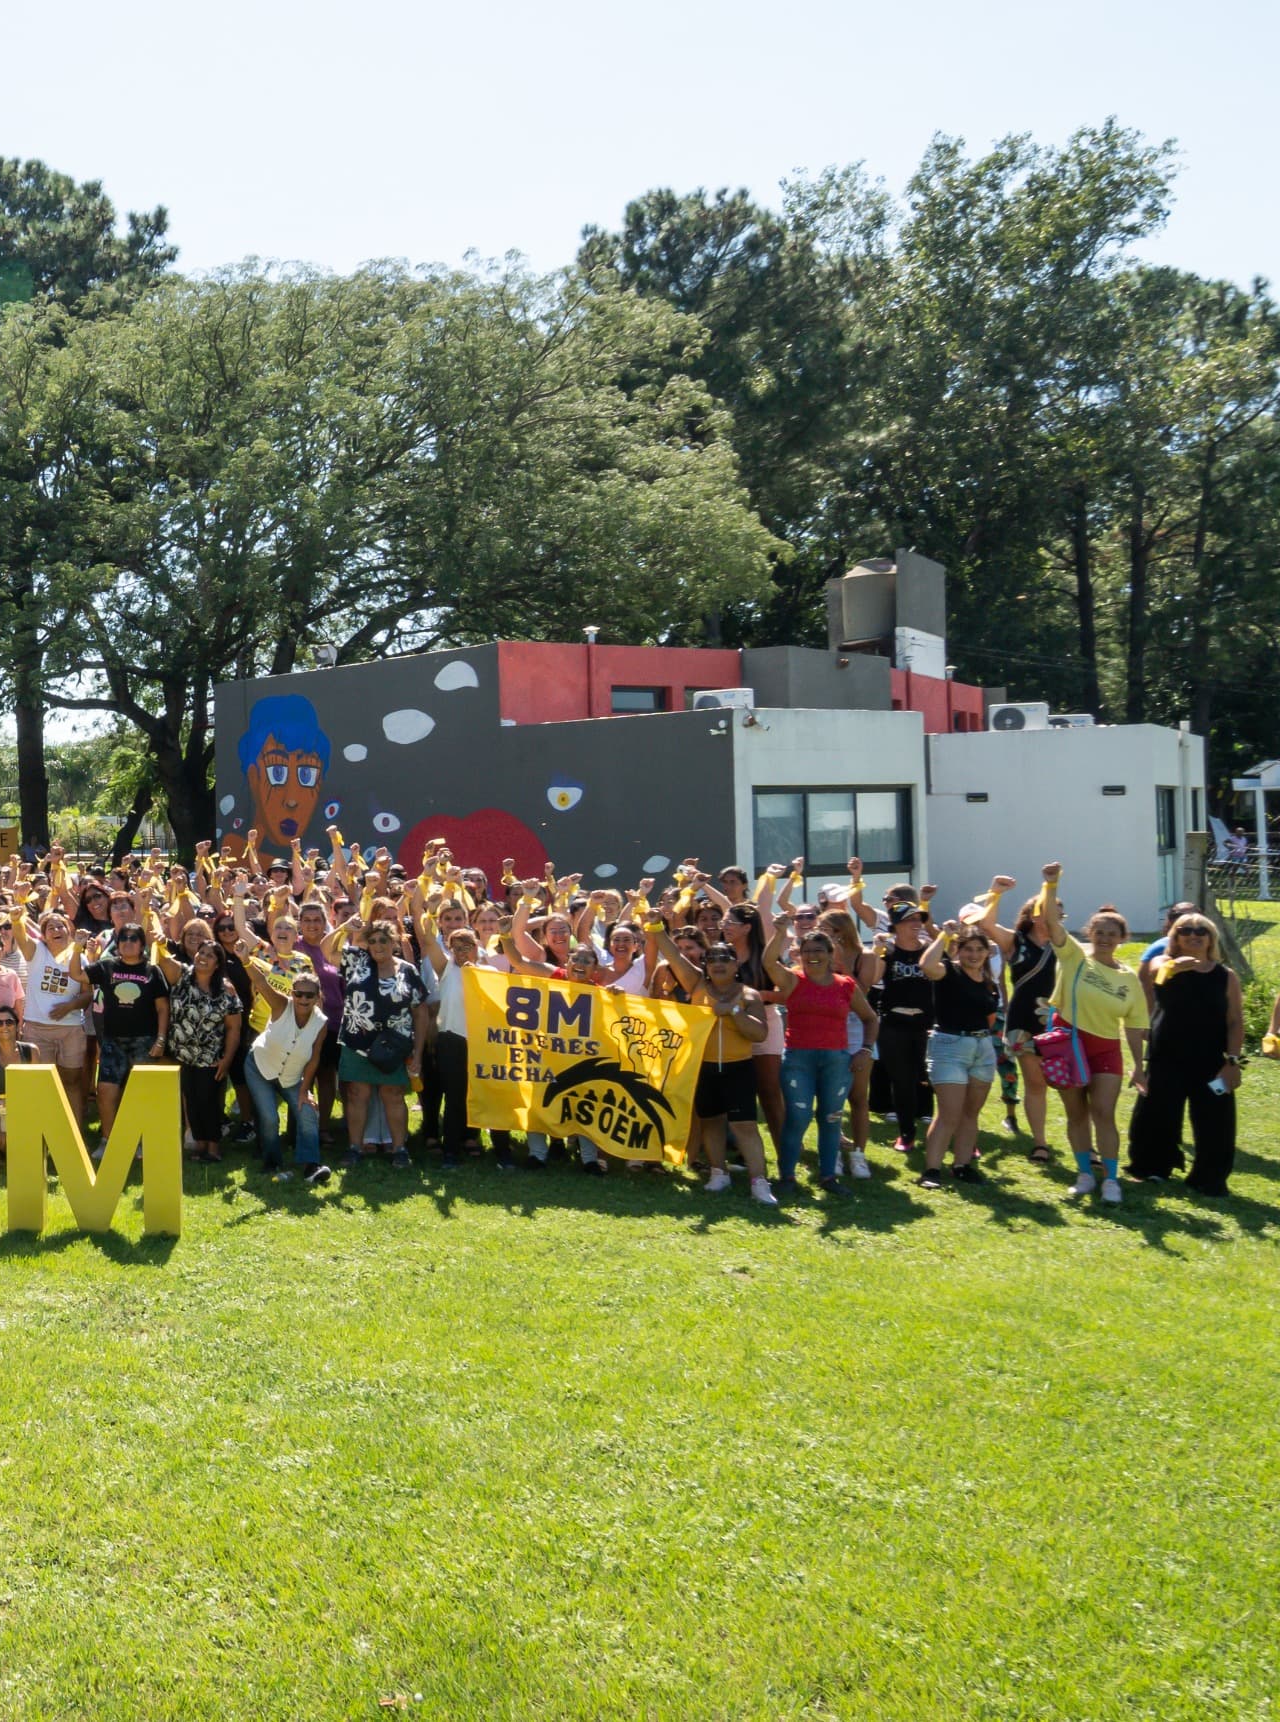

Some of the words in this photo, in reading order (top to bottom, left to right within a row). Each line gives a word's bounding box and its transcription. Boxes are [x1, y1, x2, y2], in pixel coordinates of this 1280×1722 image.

[505, 986, 593, 1037] 8M
[487, 1027, 600, 1056] MUJERES
[509, 1048, 542, 1064] EN
[475, 1064, 557, 1083] LUCHA
[560, 1097, 653, 1150] ASOEM
